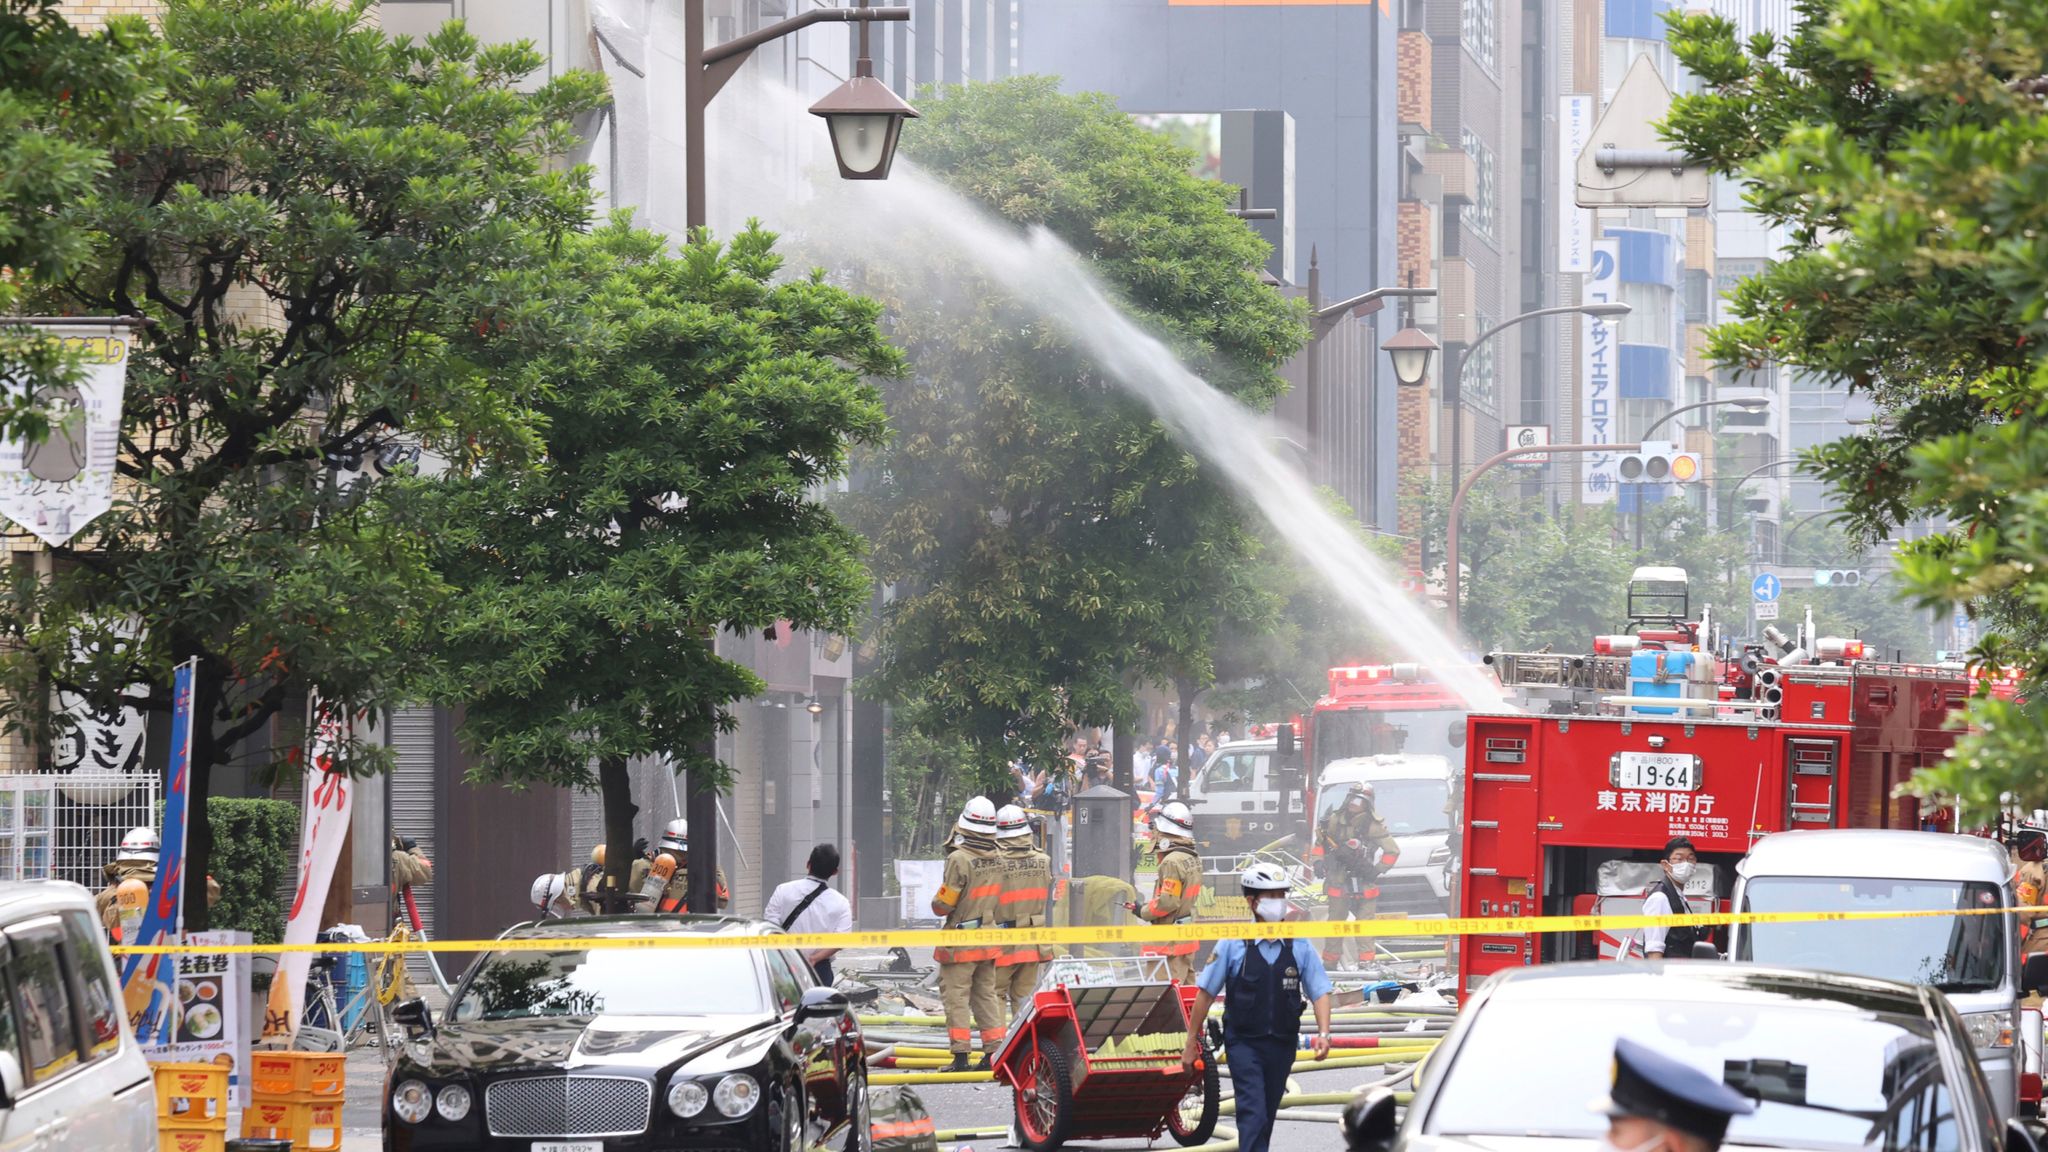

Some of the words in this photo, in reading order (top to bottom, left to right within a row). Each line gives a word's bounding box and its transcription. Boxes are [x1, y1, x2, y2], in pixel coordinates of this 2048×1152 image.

[1637, 765, 1688, 788] 19-64
[1596, 790, 1715, 815] 東京消防庁
[1004, 859, 1046, 871] 京消防庁
